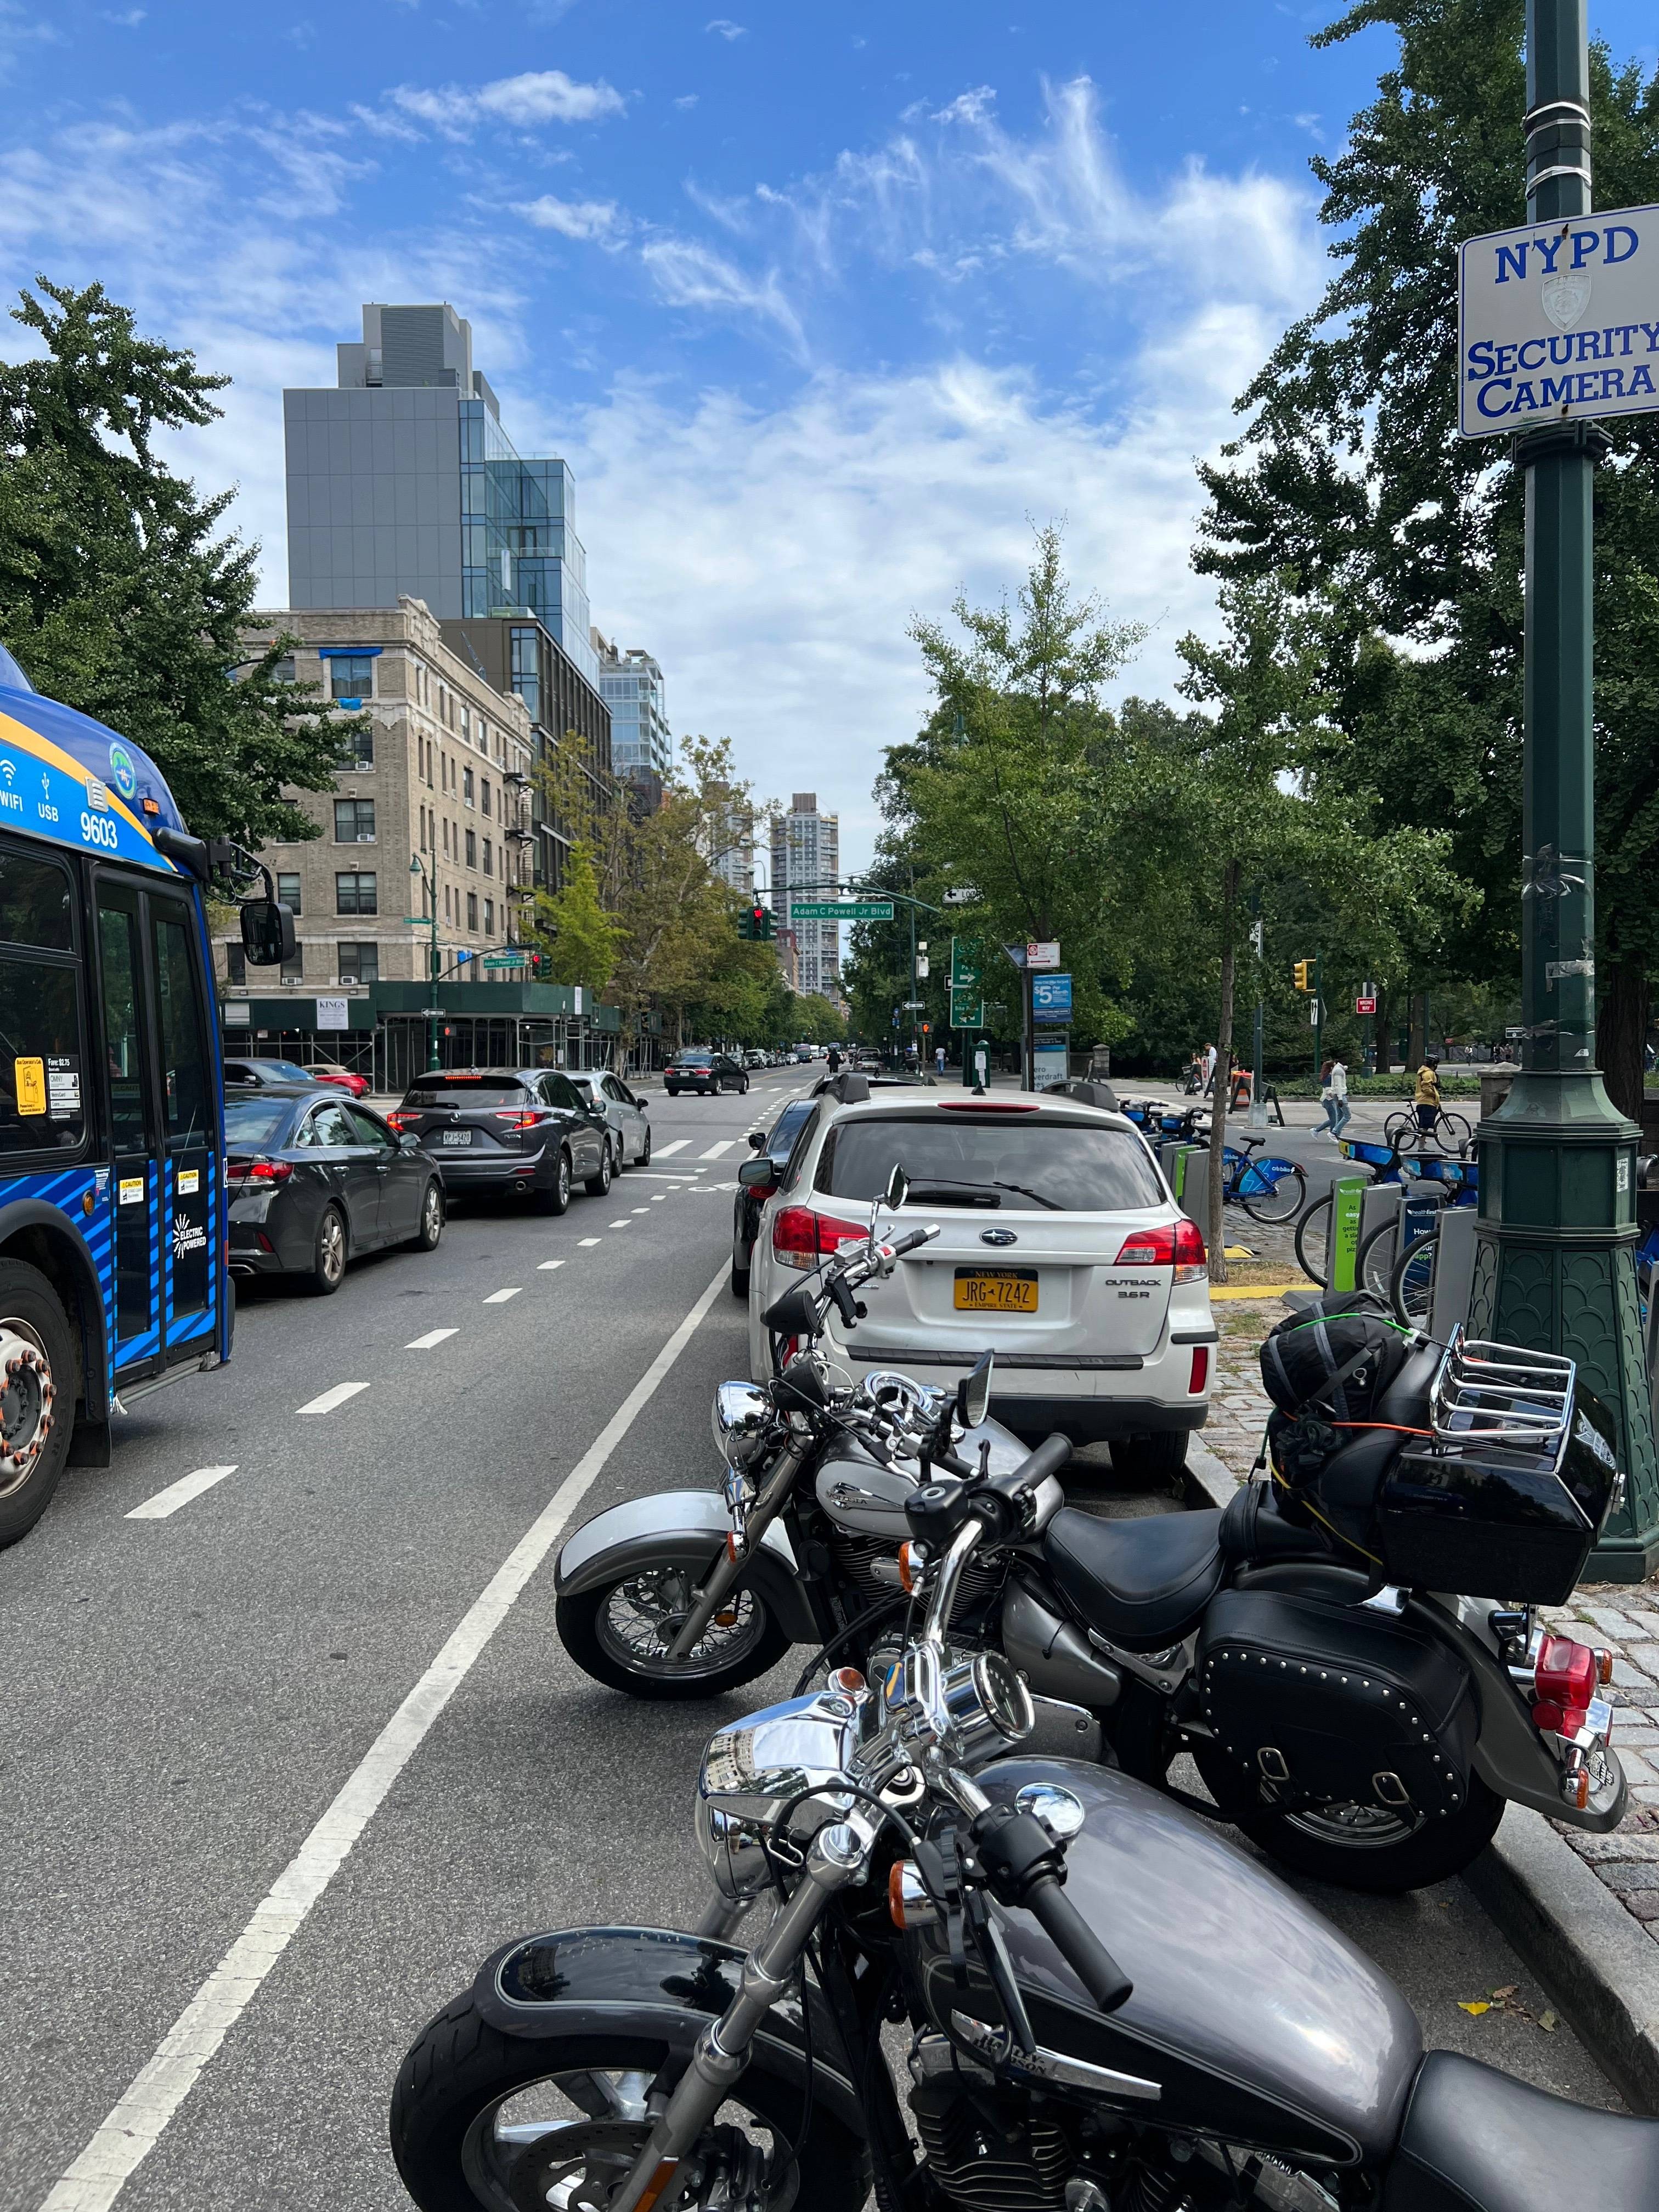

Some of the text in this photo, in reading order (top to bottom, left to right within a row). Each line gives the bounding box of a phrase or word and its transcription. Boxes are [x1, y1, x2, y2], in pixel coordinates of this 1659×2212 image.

[1494, 226, 1639, 284] NYPD
[1467, 322, 1659, 381] SECURITY
[1476, 364, 1656, 418] CAMERA
[0, 790, 23, 811] WIFI
[37, 802, 59, 822] USB
[80, 811, 118, 849] 9603
[1034, 985, 1052, 1003] $5
[180, 1226, 203, 1240] ELECTRIC
[183, 1236, 206, 1251] POWERED
[826, 1491, 868, 1504] VOLUSIA
